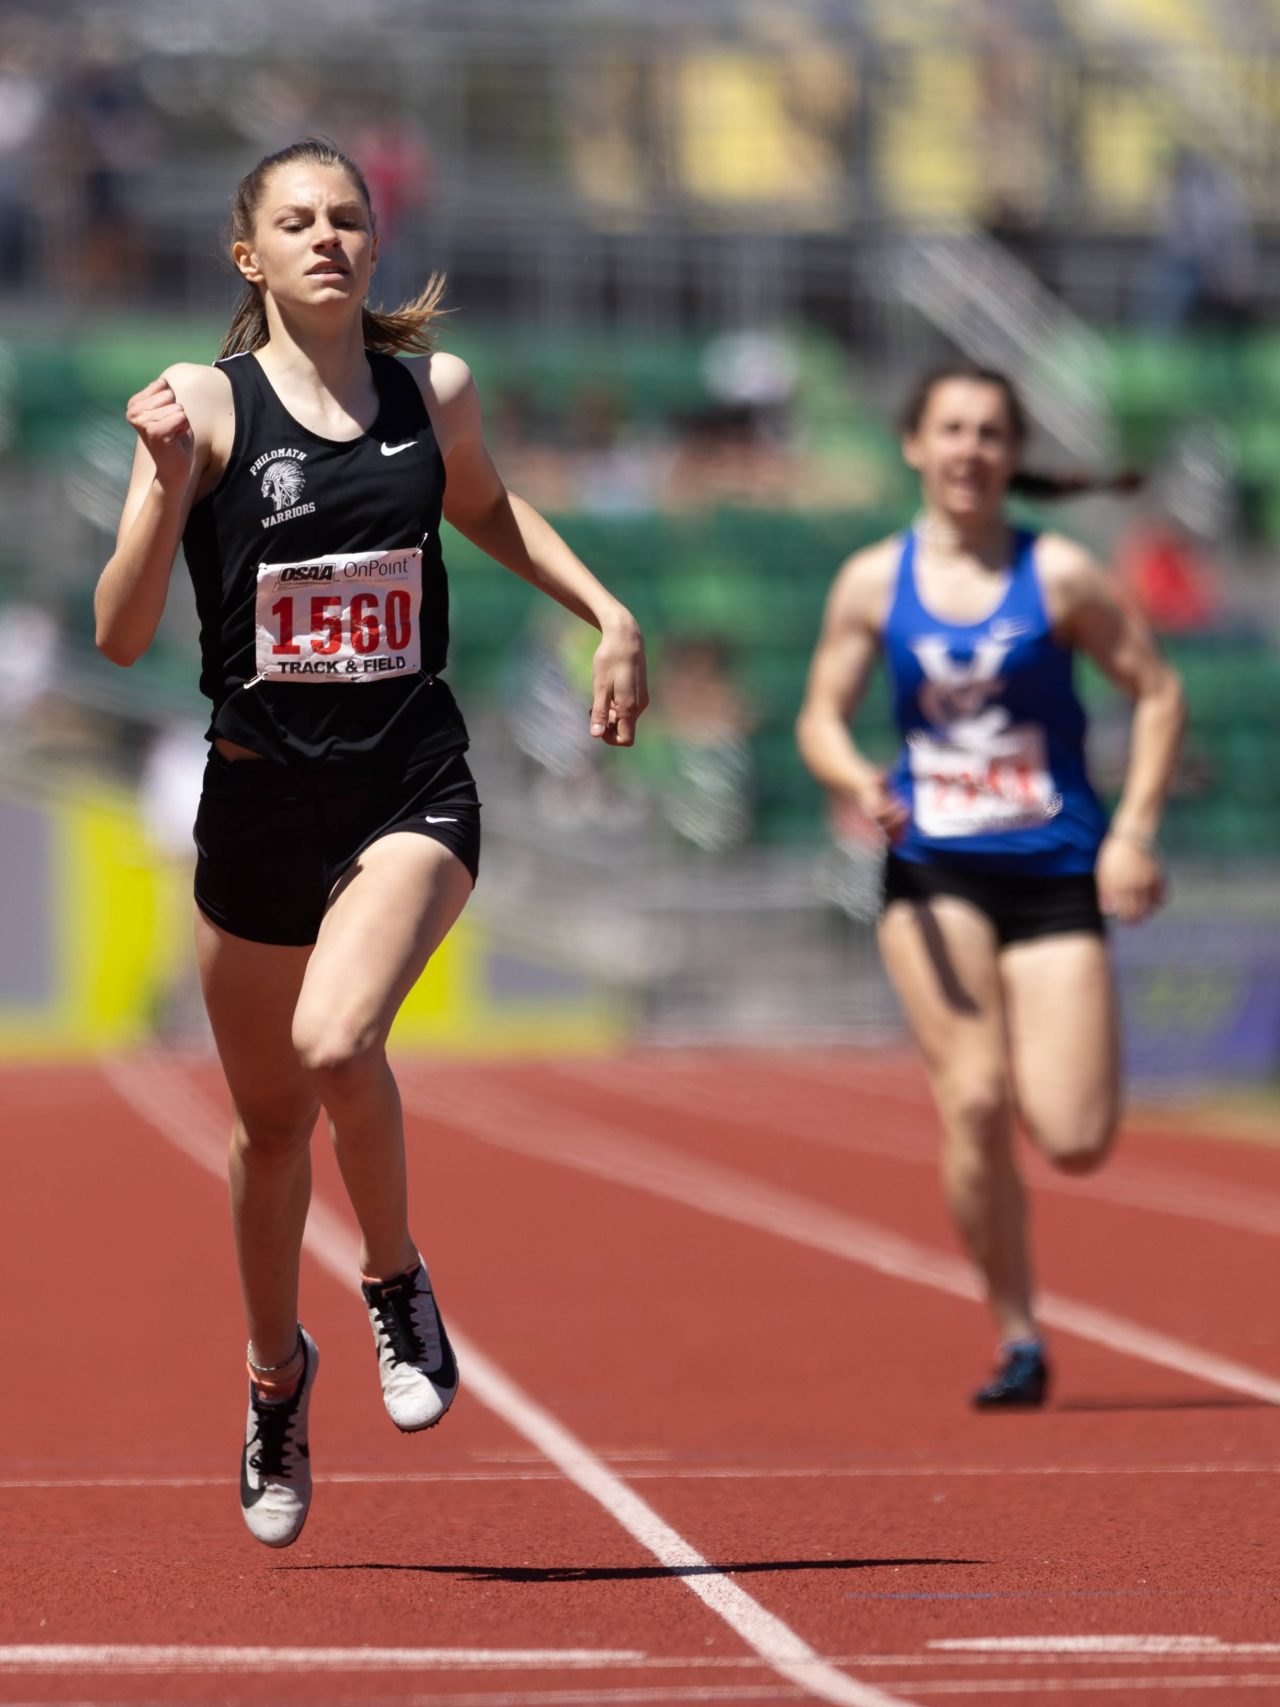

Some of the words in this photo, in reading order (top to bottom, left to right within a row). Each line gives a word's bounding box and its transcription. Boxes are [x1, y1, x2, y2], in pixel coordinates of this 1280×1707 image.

[249, 447, 308, 476] PHILOMATH
[261, 502, 316, 528] WARRIORS
[280, 565, 334, 582] OSAA
[344, 558, 408, 578] OnPoint
[272, 590, 411, 656] 1560
[278, 659, 339, 674] TRACK
[345, 659, 358, 672] &
[363, 656, 406, 671] FIELD
